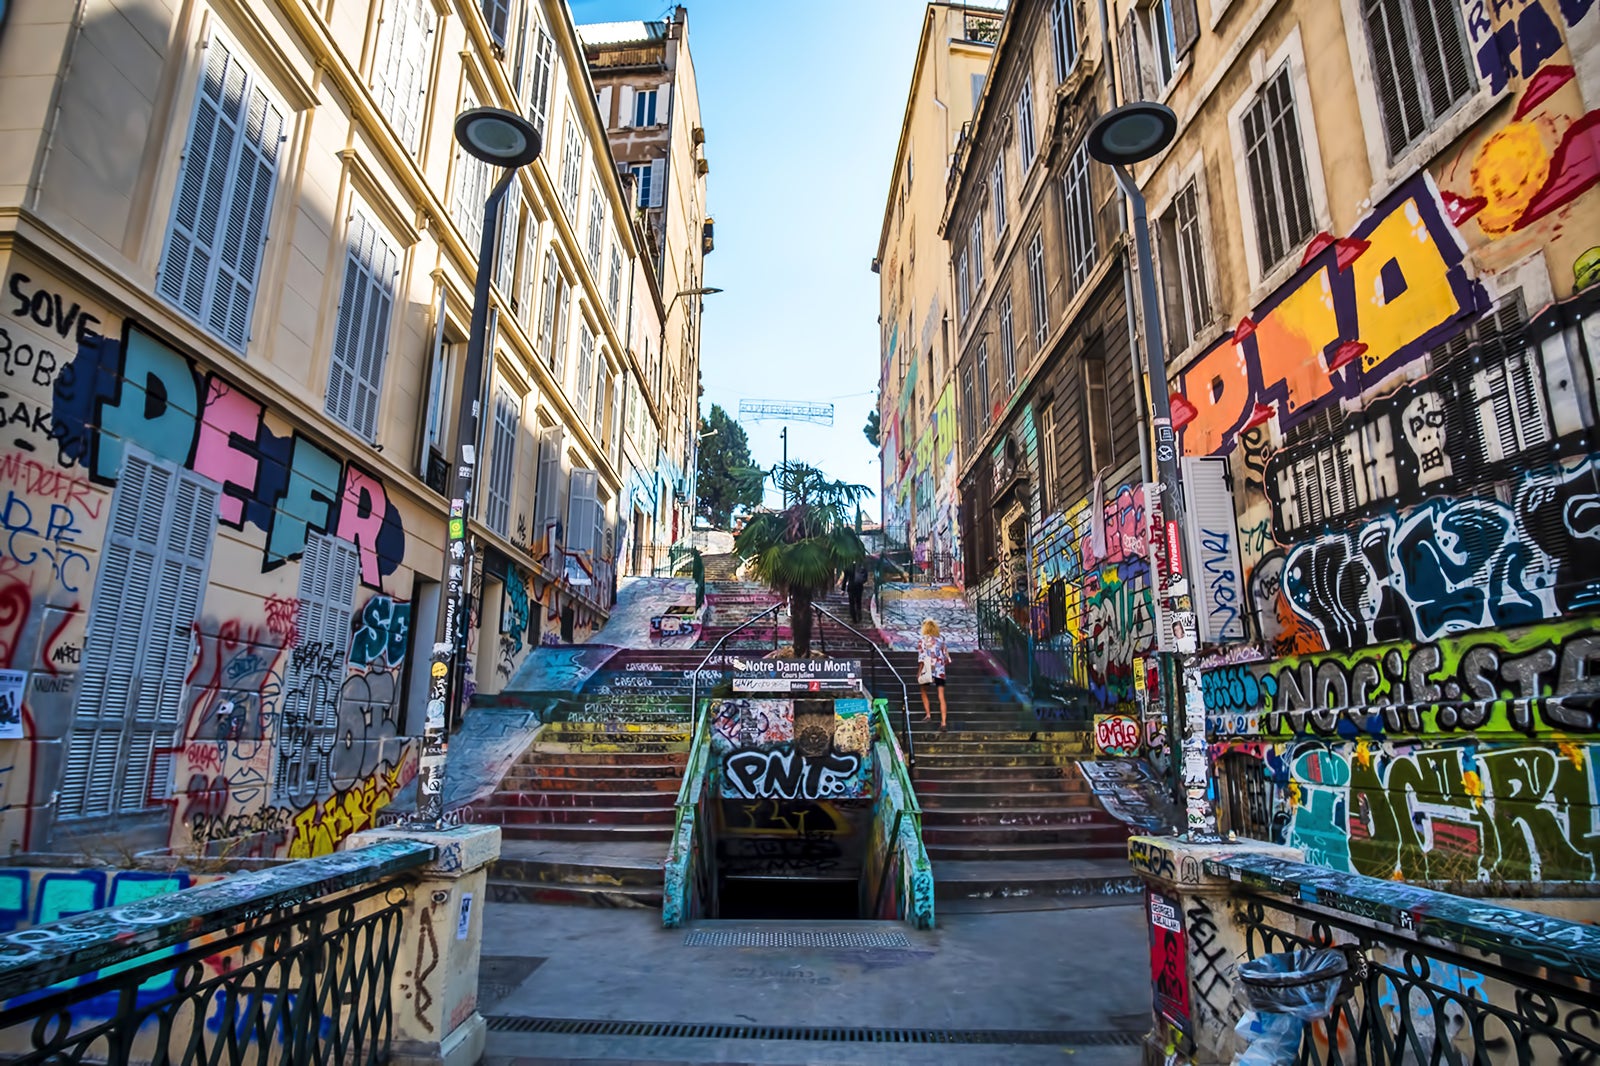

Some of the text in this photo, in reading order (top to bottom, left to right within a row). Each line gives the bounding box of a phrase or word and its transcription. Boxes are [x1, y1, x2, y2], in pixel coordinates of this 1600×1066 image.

[746, 660, 851, 672] Notre Dame du Mont
[781, 671, 798, 679] Cours
[798, 671, 815, 679] Julien
[791, 682, 808, 690] Métro
